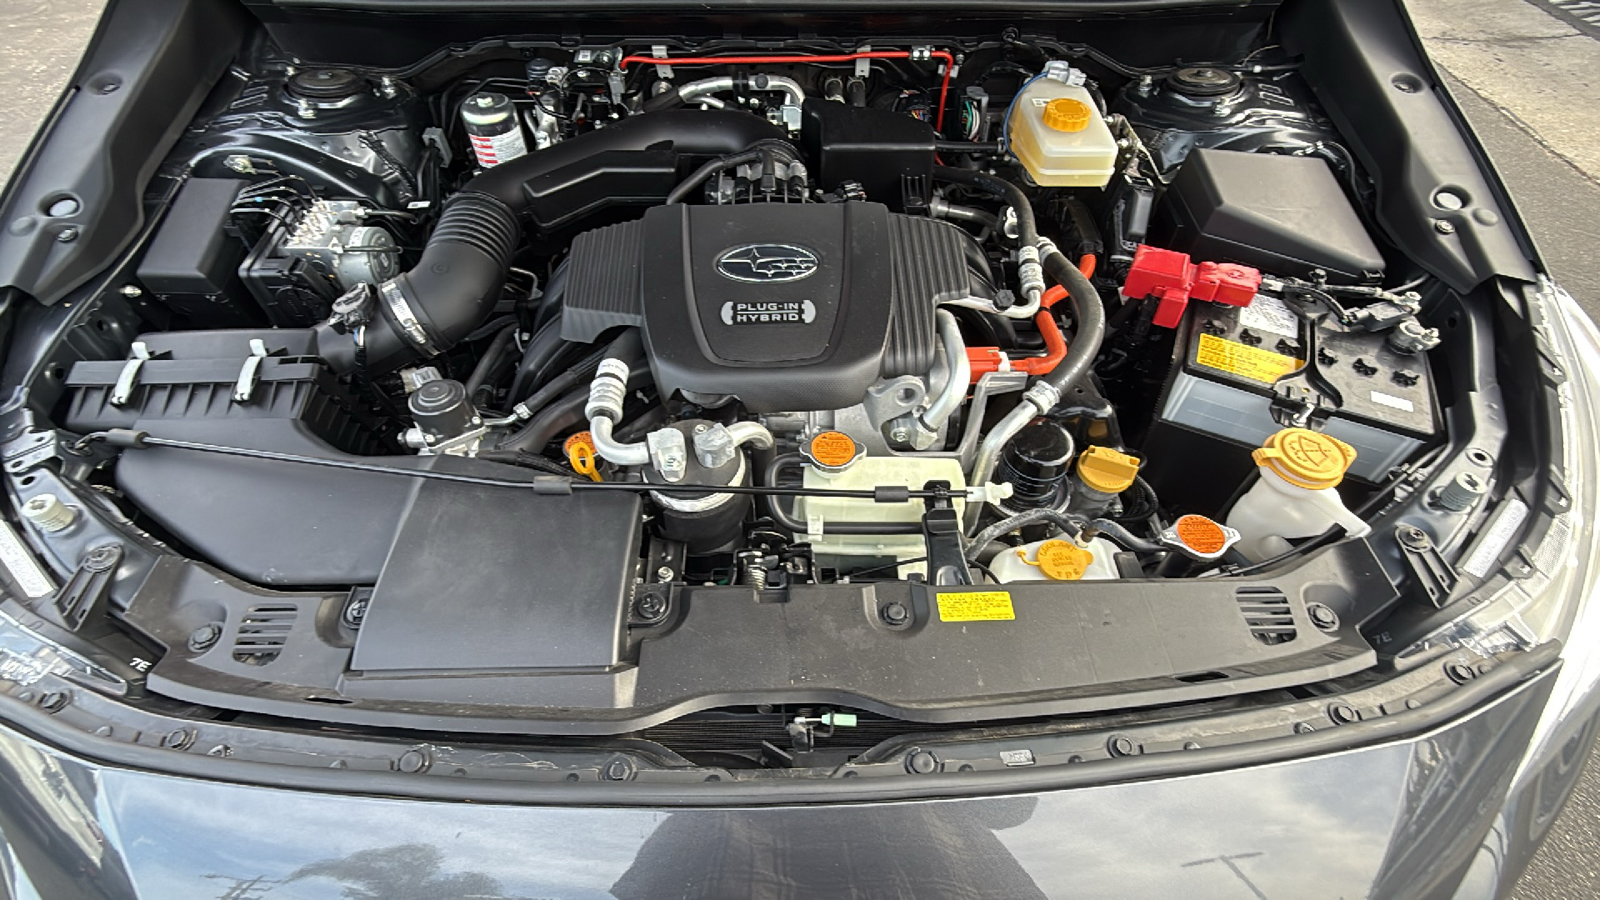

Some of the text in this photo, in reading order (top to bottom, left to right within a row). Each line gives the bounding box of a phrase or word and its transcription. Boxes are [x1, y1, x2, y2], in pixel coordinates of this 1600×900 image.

[737, 303, 799, 311] PLUG-IN
[737, 313, 799, 322] HYBRID
[1371, 631, 1393, 645] 7E
[129, 657, 153, 672] 7E
